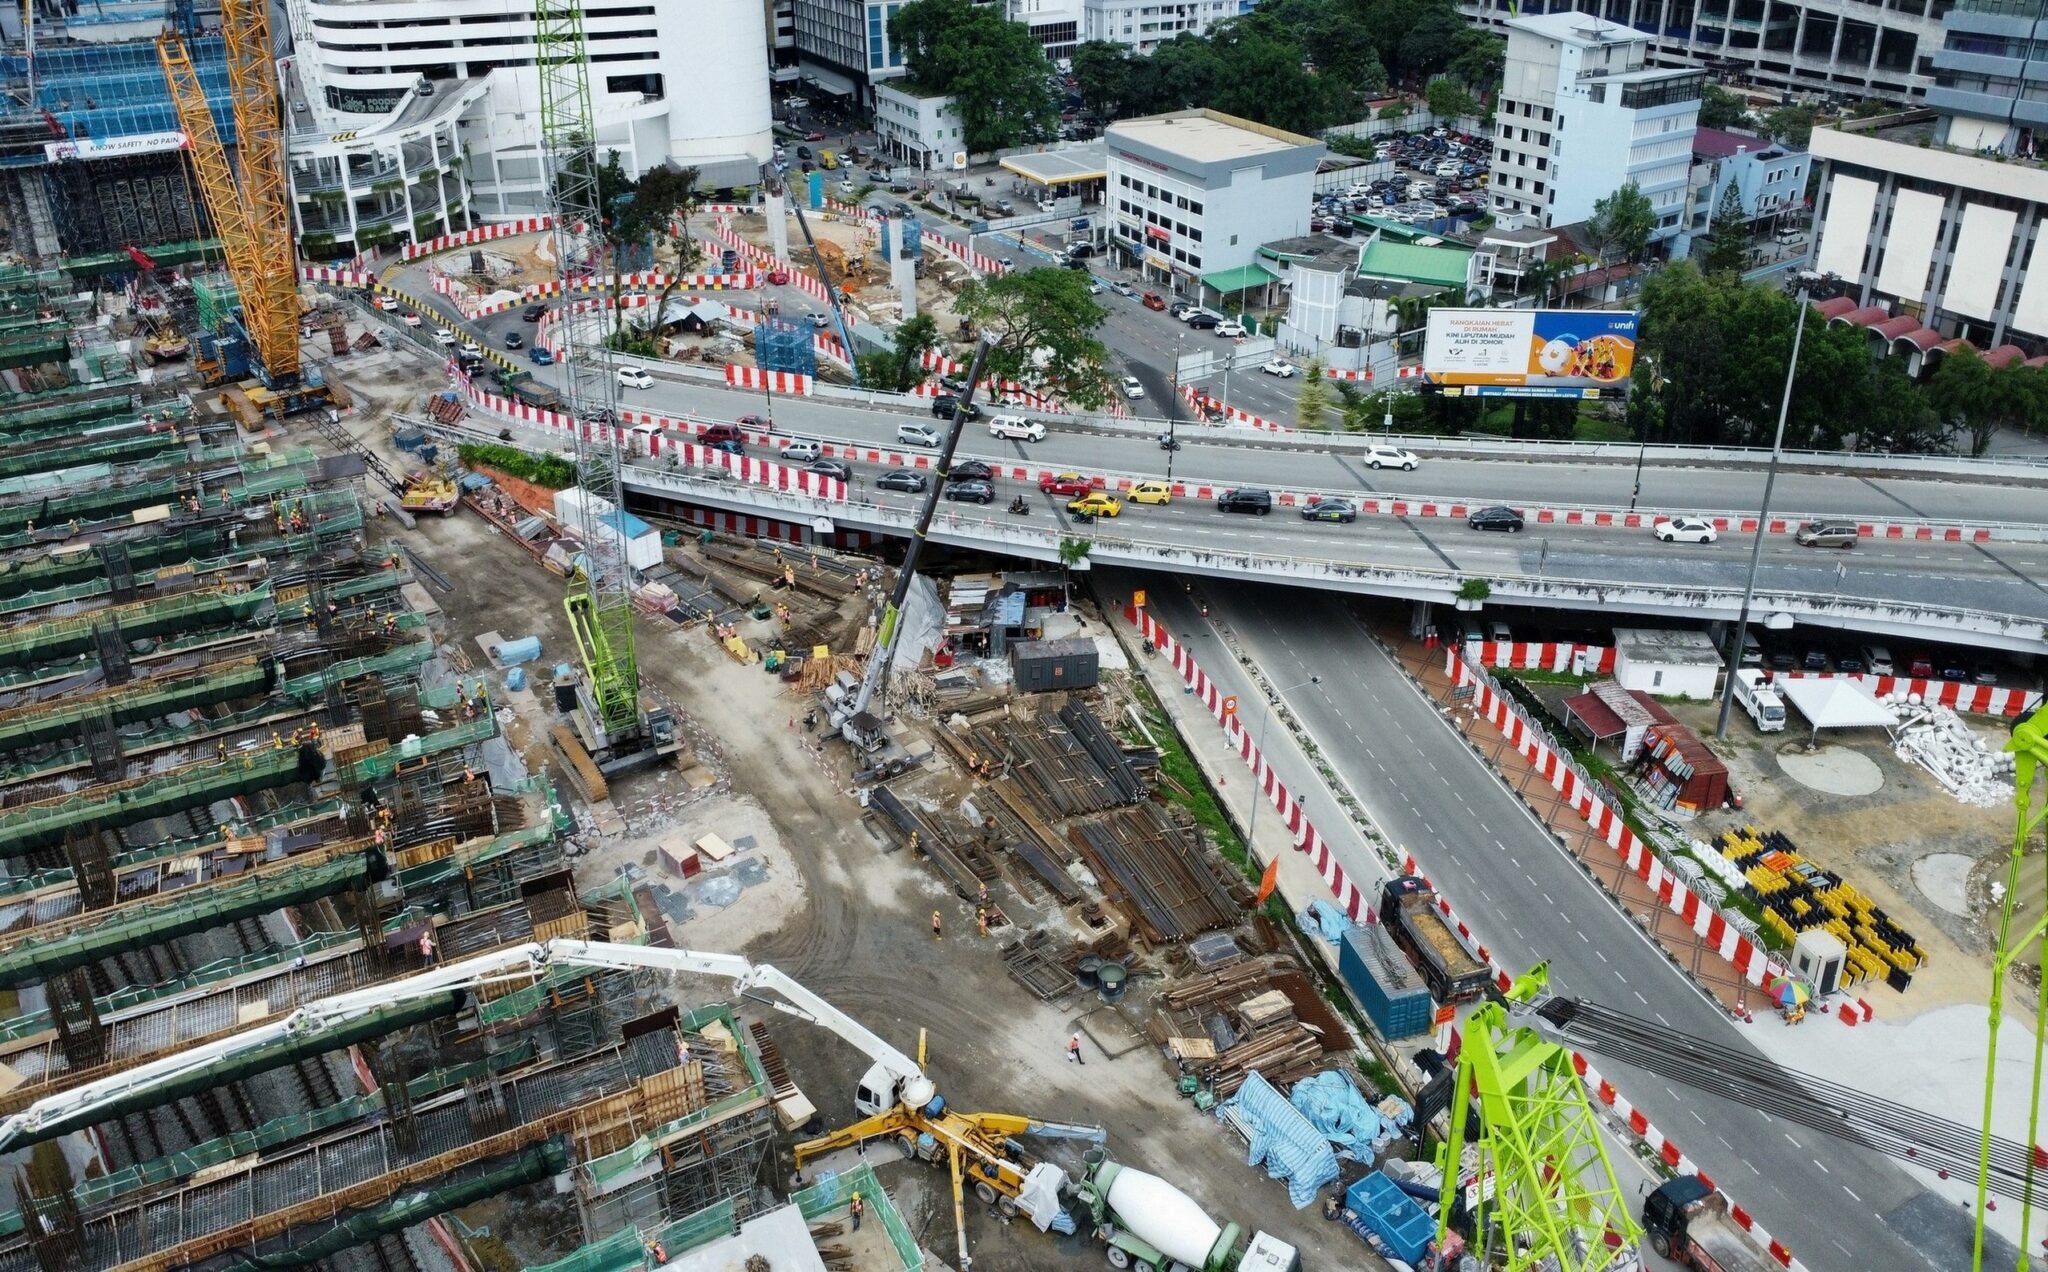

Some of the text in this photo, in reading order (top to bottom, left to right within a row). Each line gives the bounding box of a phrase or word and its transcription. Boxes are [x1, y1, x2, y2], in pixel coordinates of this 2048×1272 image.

[90, 143, 115, 152] KNOW
[118, 141, 142, 150] SAFETY
[147, 138, 158, 146] NO
[1614, 320, 1635, 330] unifi
